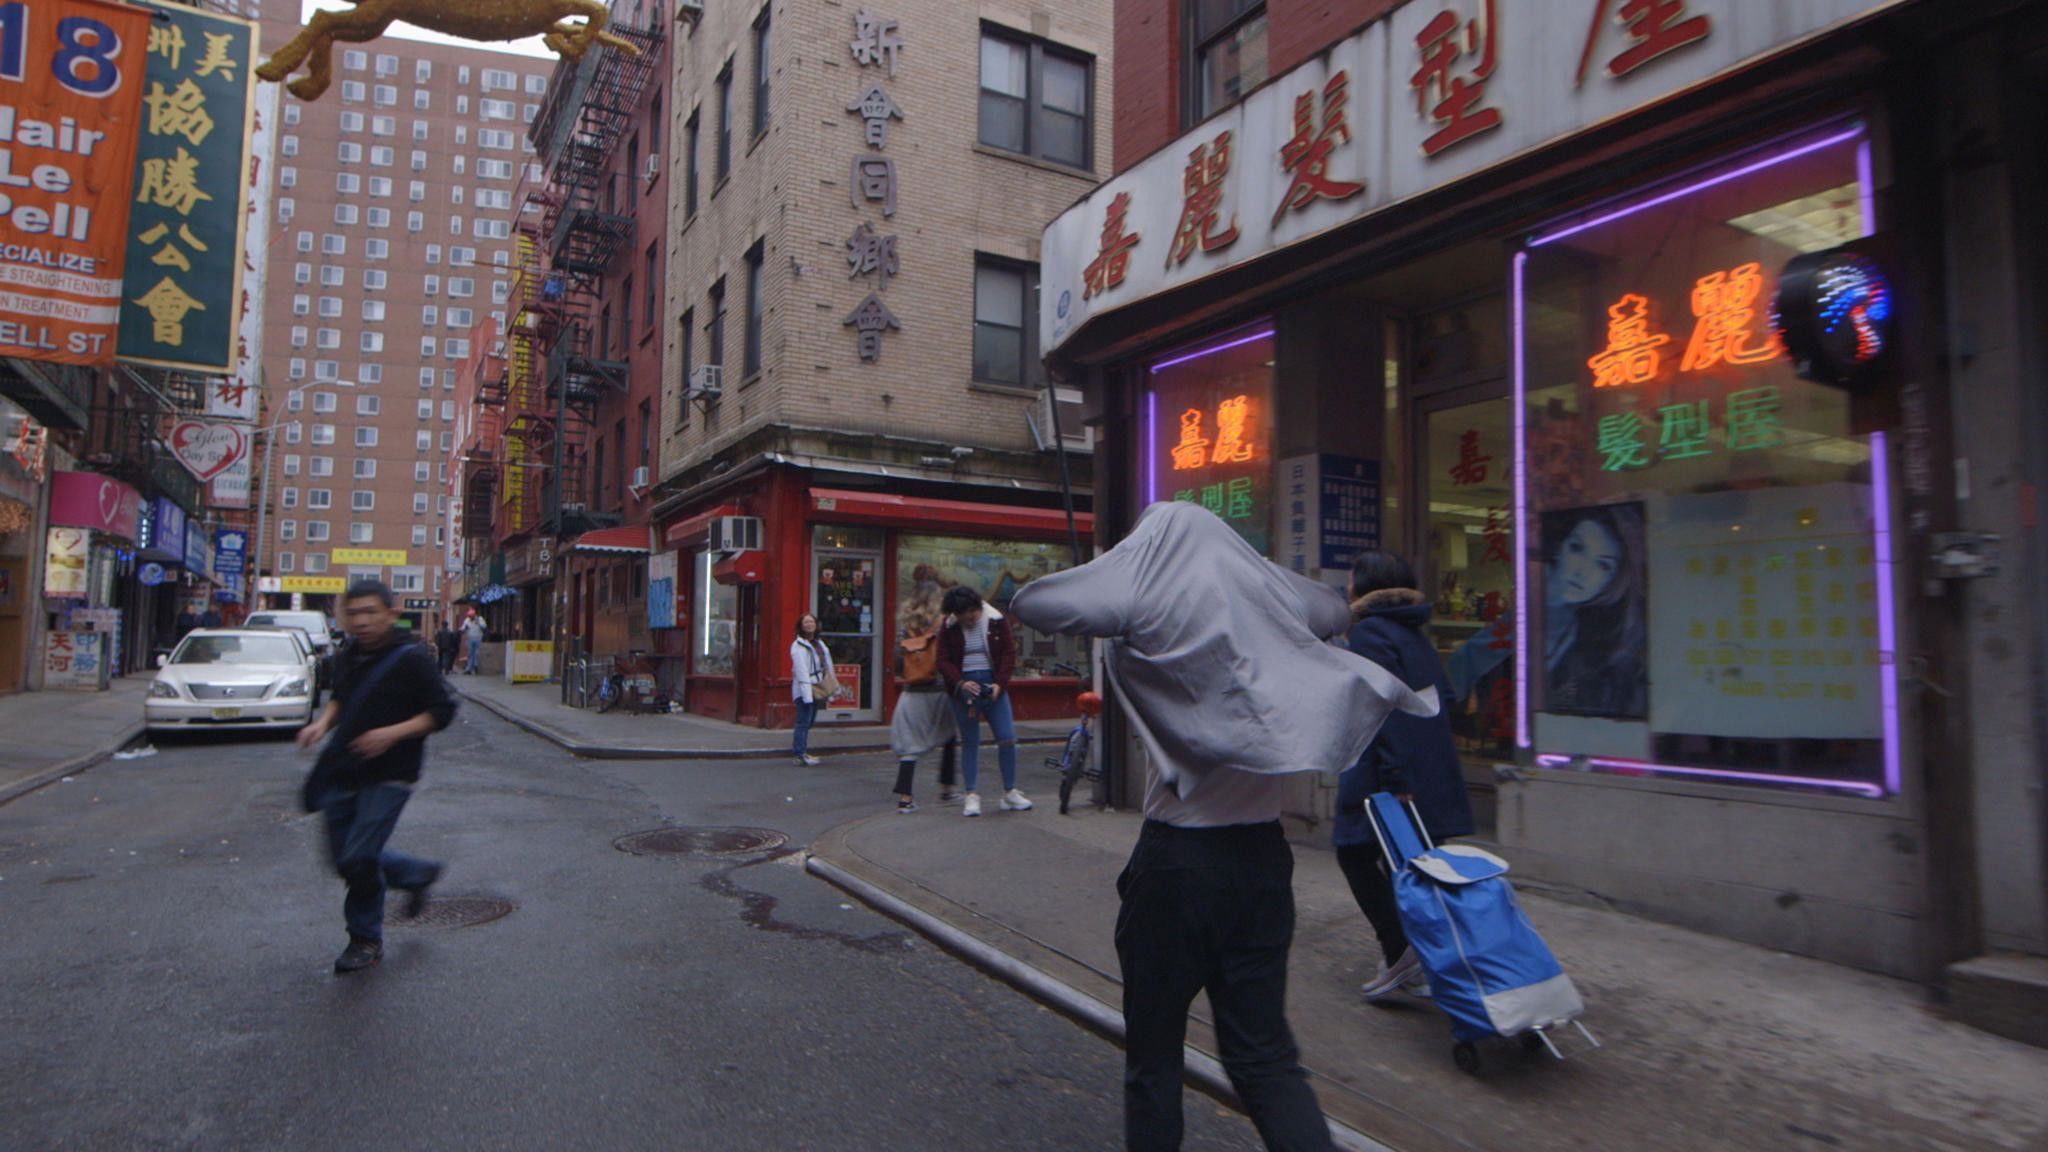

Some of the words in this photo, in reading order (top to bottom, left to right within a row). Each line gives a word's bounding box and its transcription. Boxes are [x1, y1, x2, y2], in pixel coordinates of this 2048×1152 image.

[0, 1, 122, 98] 18
[843, 7, 904, 362] 新會同鄉會
[9, 268, 112, 295] STRAIGHTENING
[15, 296, 91, 319] TREATMENT
[67, 331, 107, 355] ST
[1587, 261, 1786, 388] 嘉麗
[1170, 394, 1254, 470] 嘉麗
[1597, 385, 1783, 471] 髮型屋
